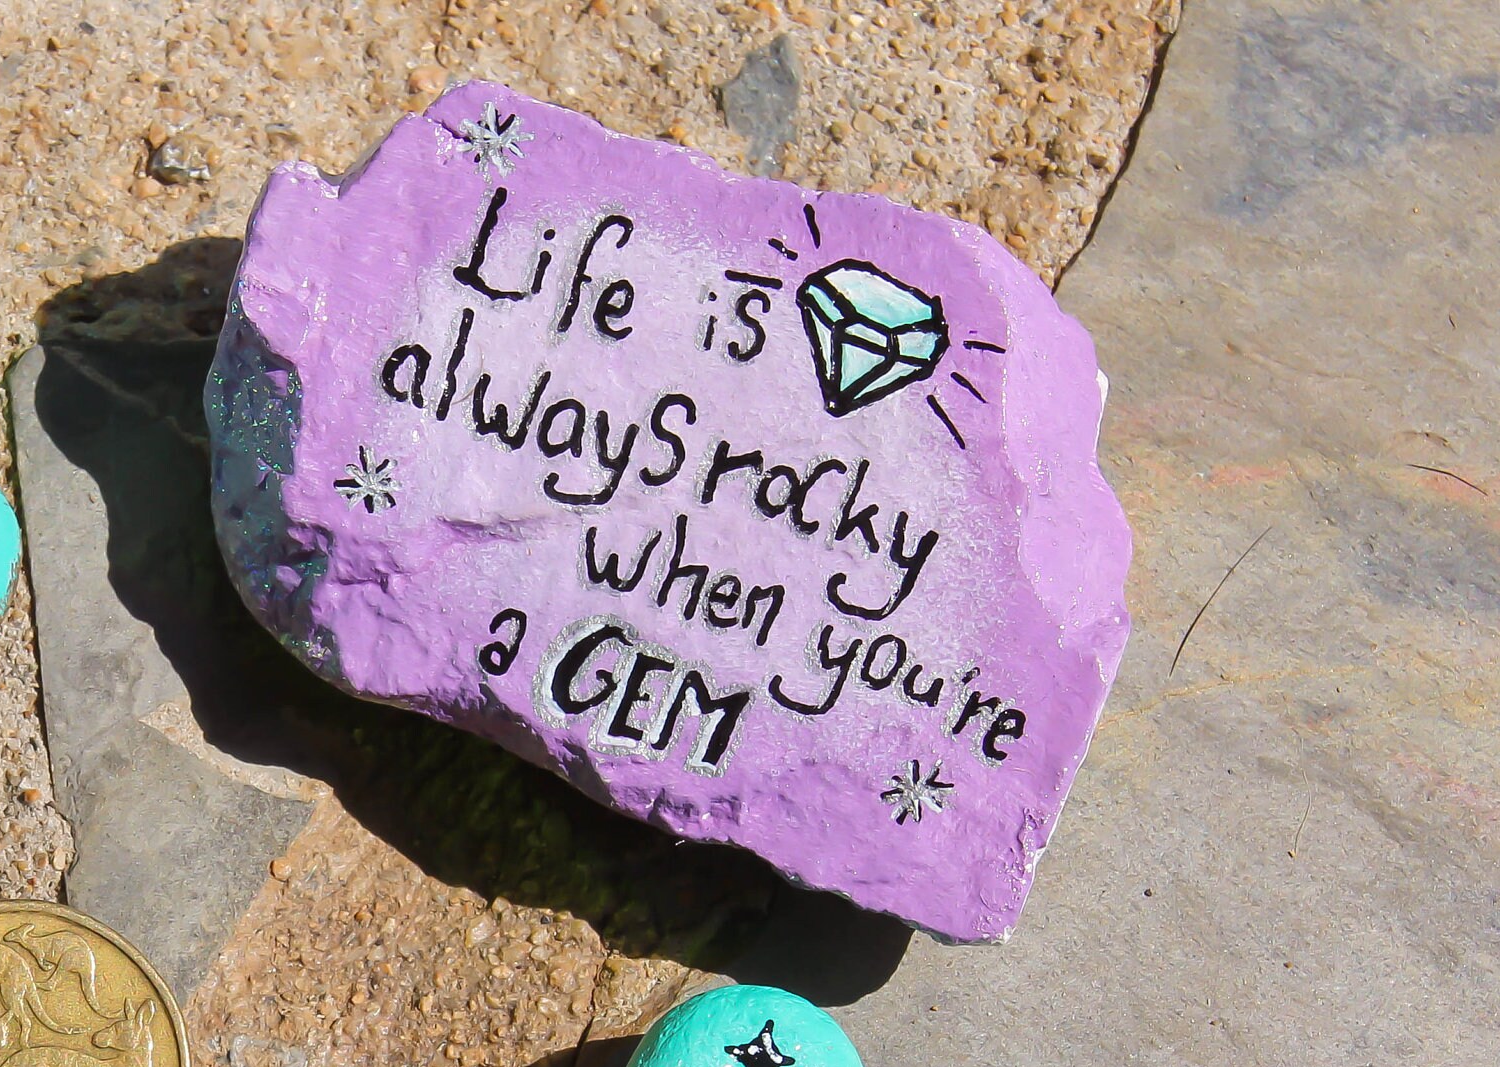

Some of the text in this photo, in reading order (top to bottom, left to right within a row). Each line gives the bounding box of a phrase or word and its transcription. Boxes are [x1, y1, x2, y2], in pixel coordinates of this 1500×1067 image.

[451, 186, 773, 364] Life is
[380, 308, 939, 621] always rocky
[478, 608, 751, 768] a GEM
[583, 514, 1027, 762] when you're
